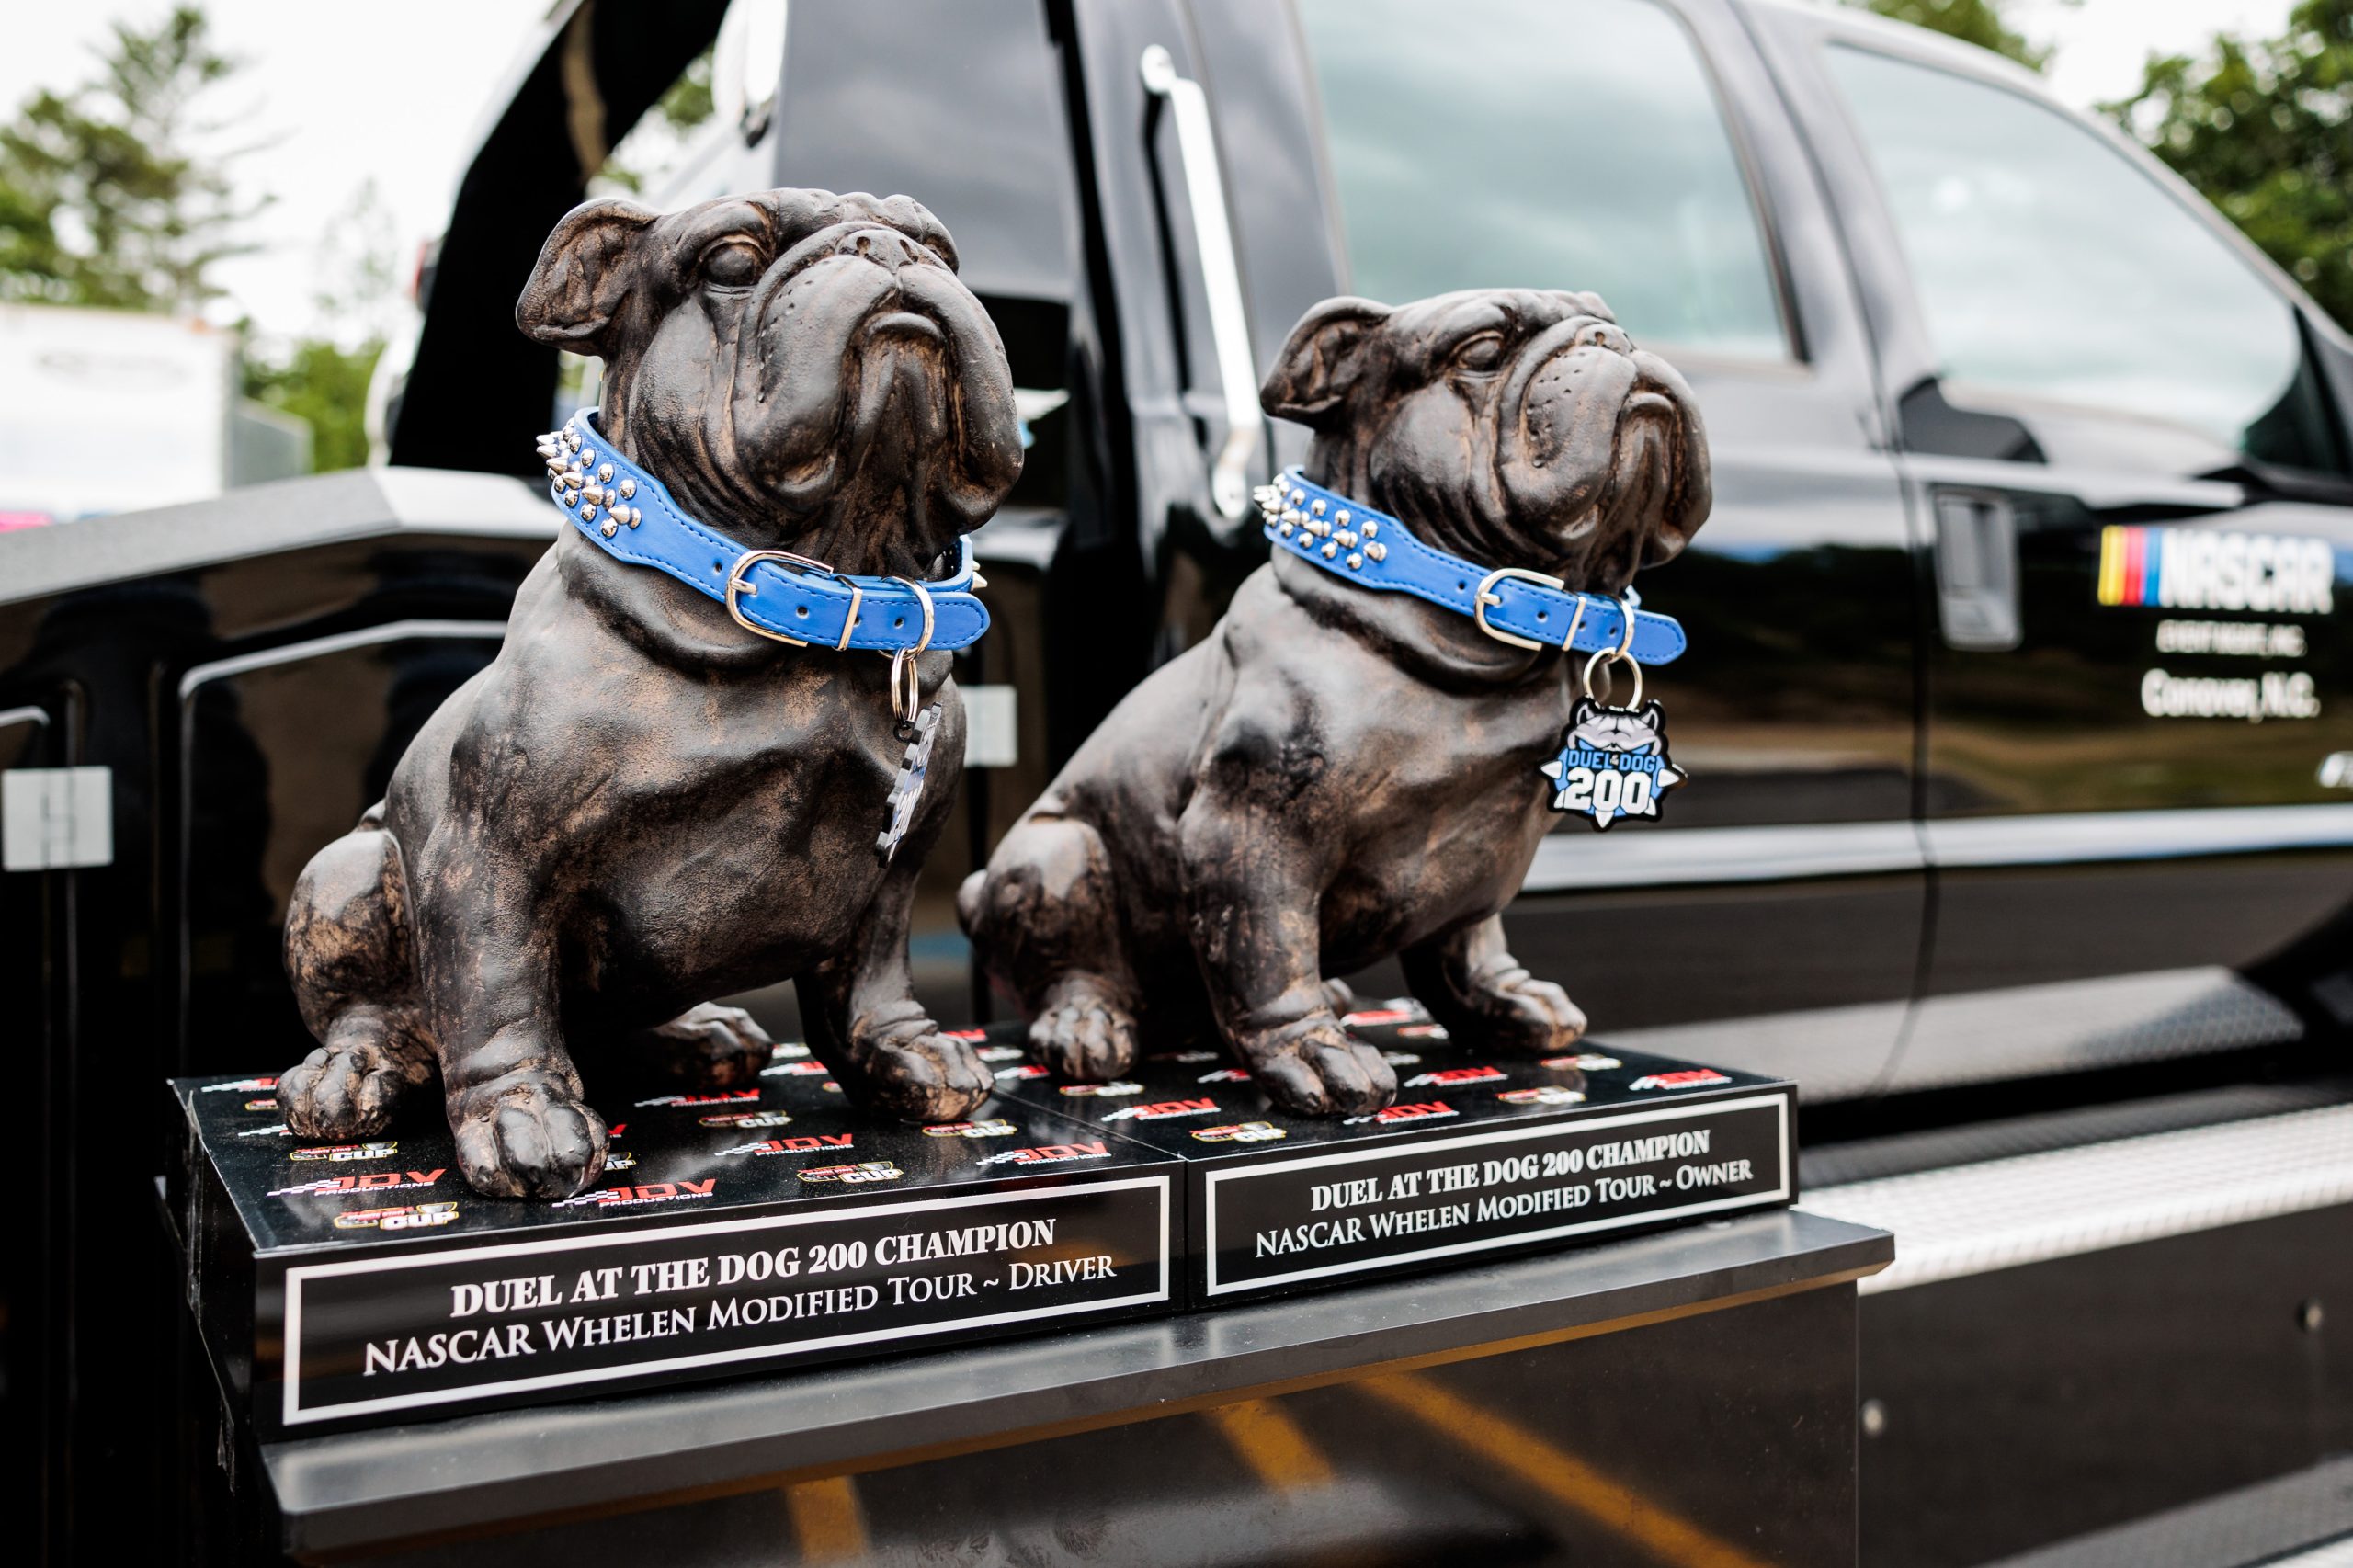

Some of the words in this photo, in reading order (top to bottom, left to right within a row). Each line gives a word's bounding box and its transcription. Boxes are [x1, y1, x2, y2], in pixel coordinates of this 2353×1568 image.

[1568, 750, 1613, 769] DUEL
[1619, 754, 1655, 773] DOG
[1563, 767, 1652, 814] 200
[754, 1133, 853, 1153] JDV
[756, 1143, 854, 1156] PRODUCTIONS
[1014, 1142, 1108, 1163] JDV
[329, 1148, 397, 1161] CUP
[317, 1168, 447, 1191] JDV
[839, 1168, 904, 1184] CUP
[1310, 1177, 1382, 1211] DUEL
[1387, 1171, 1422, 1200] AT
[1427, 1163, 1480, 1194] THE
[1483, 1154, 1540, 1187] DOG
[1542, 1148, 1584, 1176] 200
[1586, 1130, 1711, 1170] CHAMPION
[314, 1181, 434, 1196] PRODUCTIONS
[597, 1178, 716, 1202] JDV
[599, 1191, 713, 1207] PRODUCTIONS
[1256, 1218, 1366, 1257] NASCAR
[1369, 1203, 1470, 1238] WHELEN
[1476, 1184, 1591, 1222] MODIFIED
[1595, 1175, 1657, 1203] TOUR
[1676, 1159, 1754, 1189] OWNER
[380, 1210, 459, 1231] CUP
[449, 1274, 563, 1318] DUEL
[569, 1267, 623, 1303] AT
[631, 1256, 710, 1295] THE
[717, 1246, 801, 1286] DOG
[808, 1241, 867, 1274] 200
[875, 1218, 1056, 1265] CHAMPION
[363, 1324, 536, 1377] NASCAR
[541, 1306, 697, 1351] WHELEN
[707, 1285, 879, 1331] MODIFIED
[888, 1268, 978, 1306] TOUR
[1008, 1256, 1117, 1291] DRIVER
